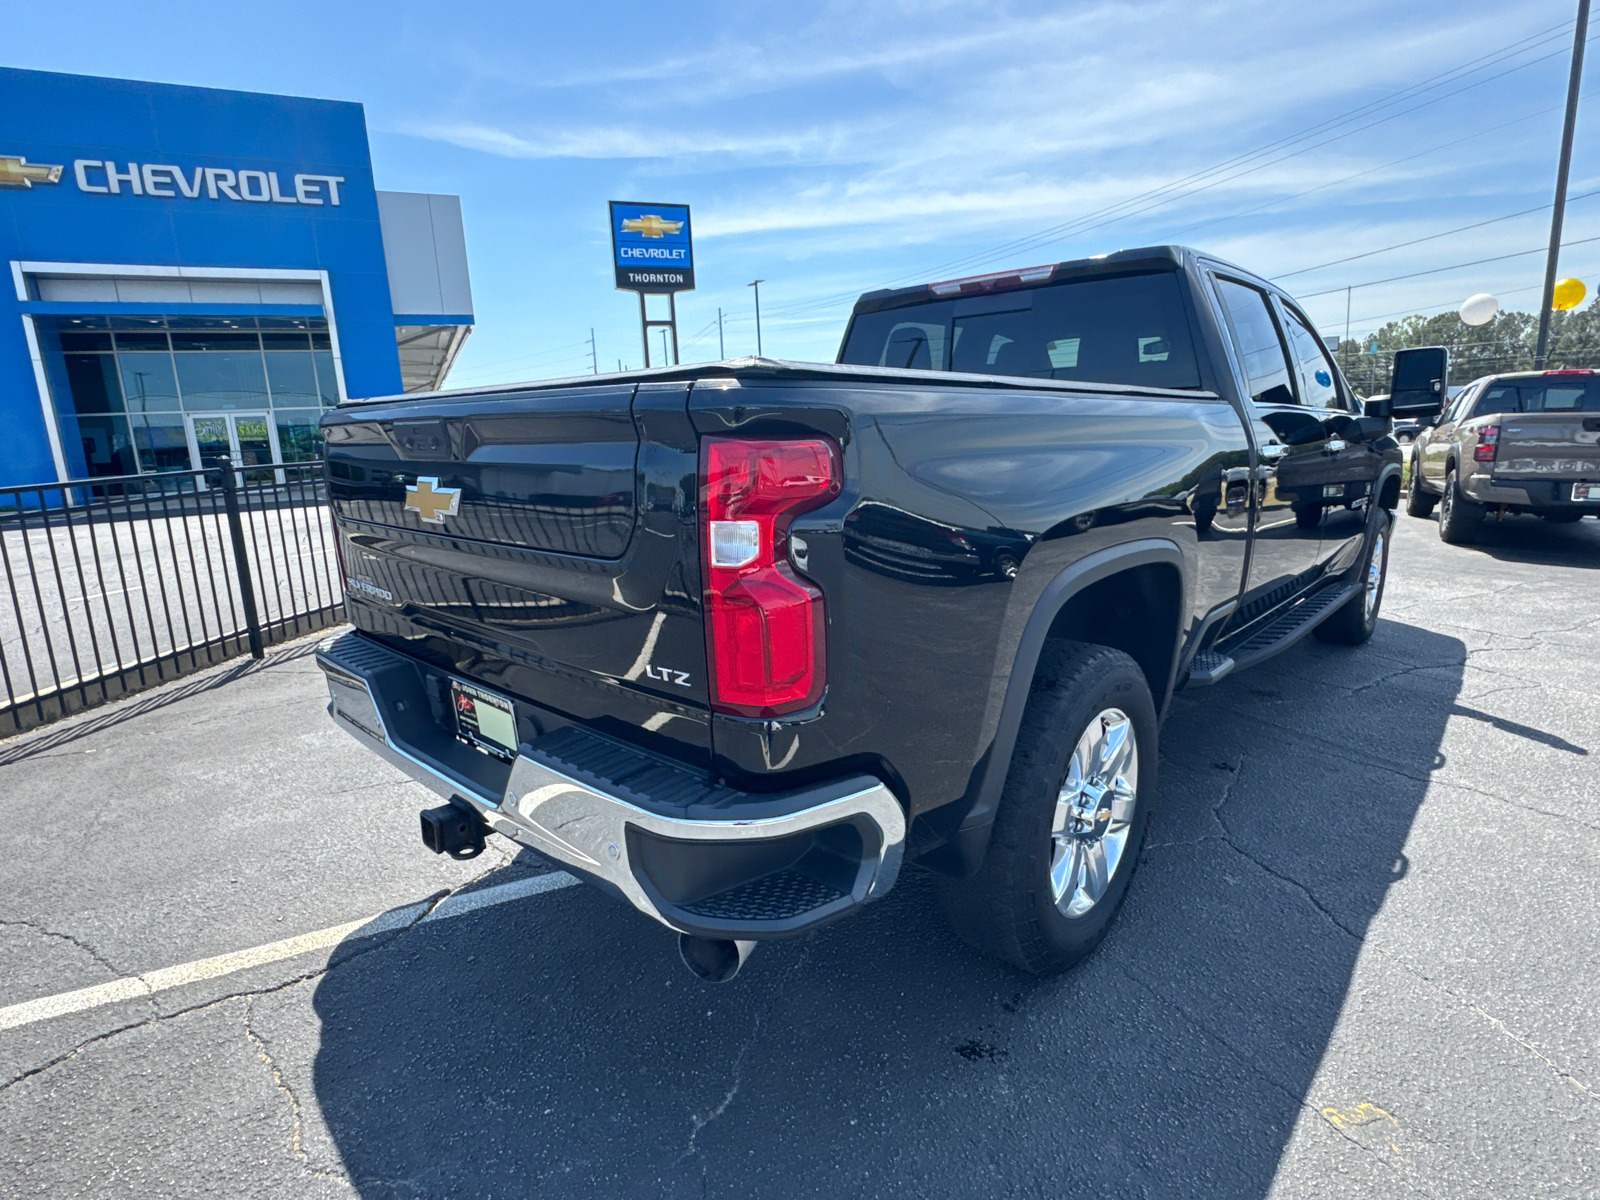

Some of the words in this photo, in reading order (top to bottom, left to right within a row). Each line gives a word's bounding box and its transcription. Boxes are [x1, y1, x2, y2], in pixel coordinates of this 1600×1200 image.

[73, 159, 345, 206] CHEVROLET
[620, 247, 686, 259] CHEVROLET
[628, 273, 683, 283] THORNTON
[645, 664, 692, 687] LTZ
[461, 684, 478, 697] JOHN
[477, 690, 510, 710] THORNTON
